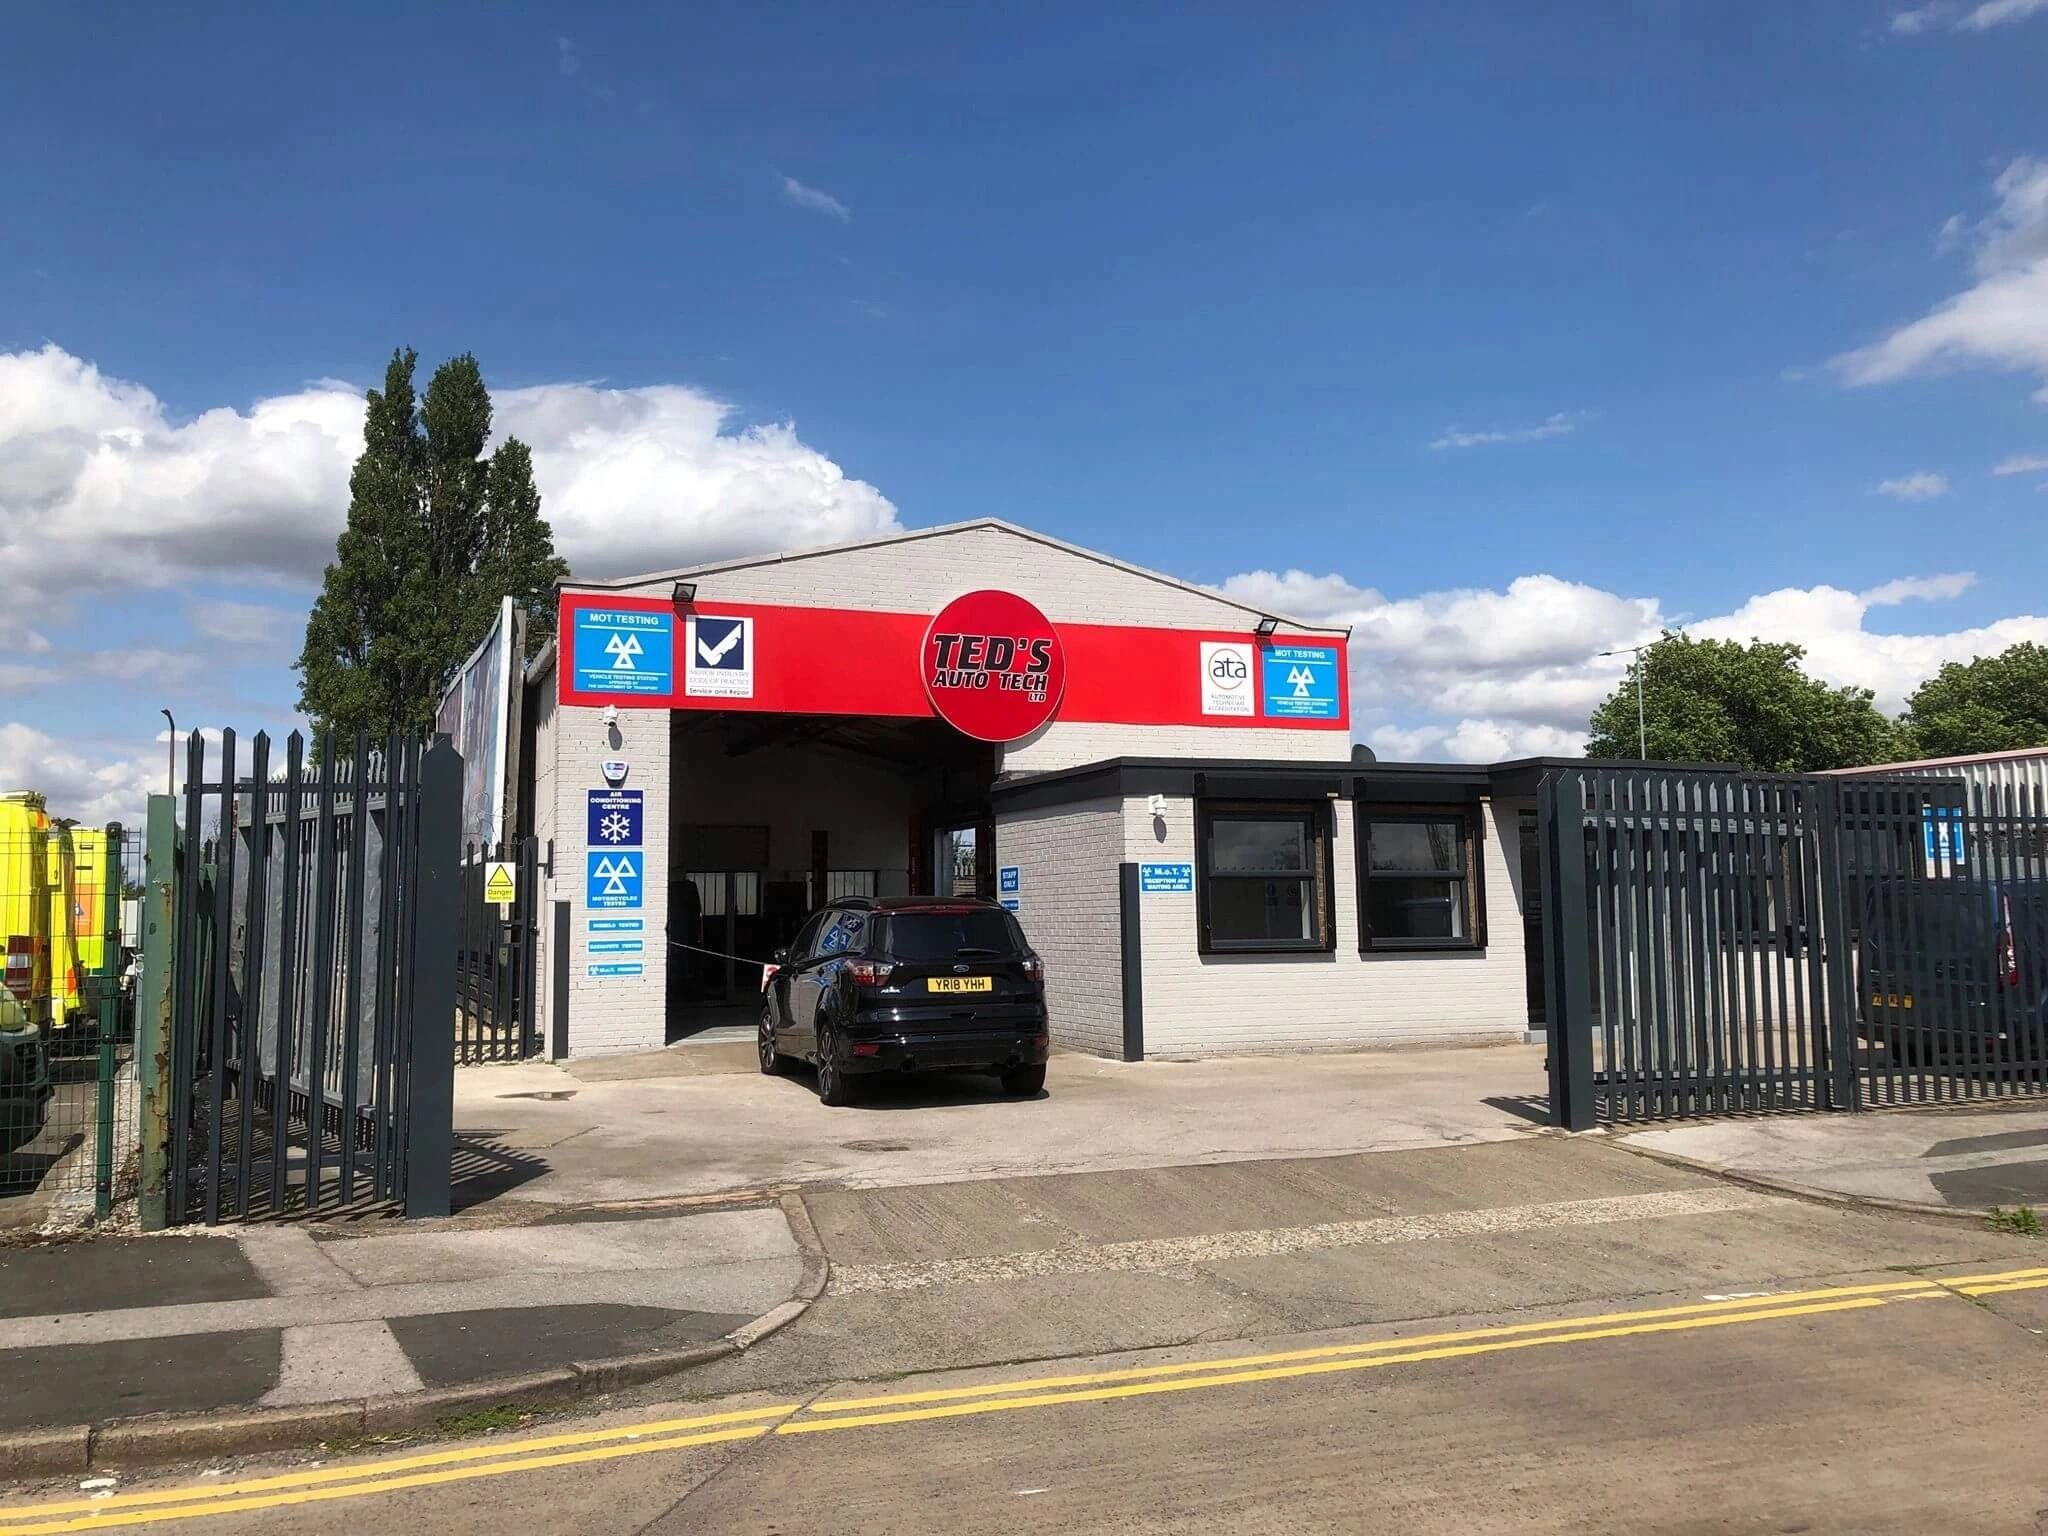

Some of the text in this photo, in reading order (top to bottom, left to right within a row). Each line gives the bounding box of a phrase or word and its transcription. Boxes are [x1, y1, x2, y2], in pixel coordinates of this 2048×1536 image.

[590, 613, 659, 625] MOT TESTING
[933, 633, 1053, 674] TED'S
[1293, 650, 1325, 659] TESTING
[1213, 658, 1247, 679] ata
[932, 670, 1048, 692] AUTO TECH
[1028, 692, 1046, 702] LTD
[1002, 870, 1016, 879] STAFF
[1003, 880, 1016, 888] ONLY
[936, 979, 985, 990] YR18 YHH
